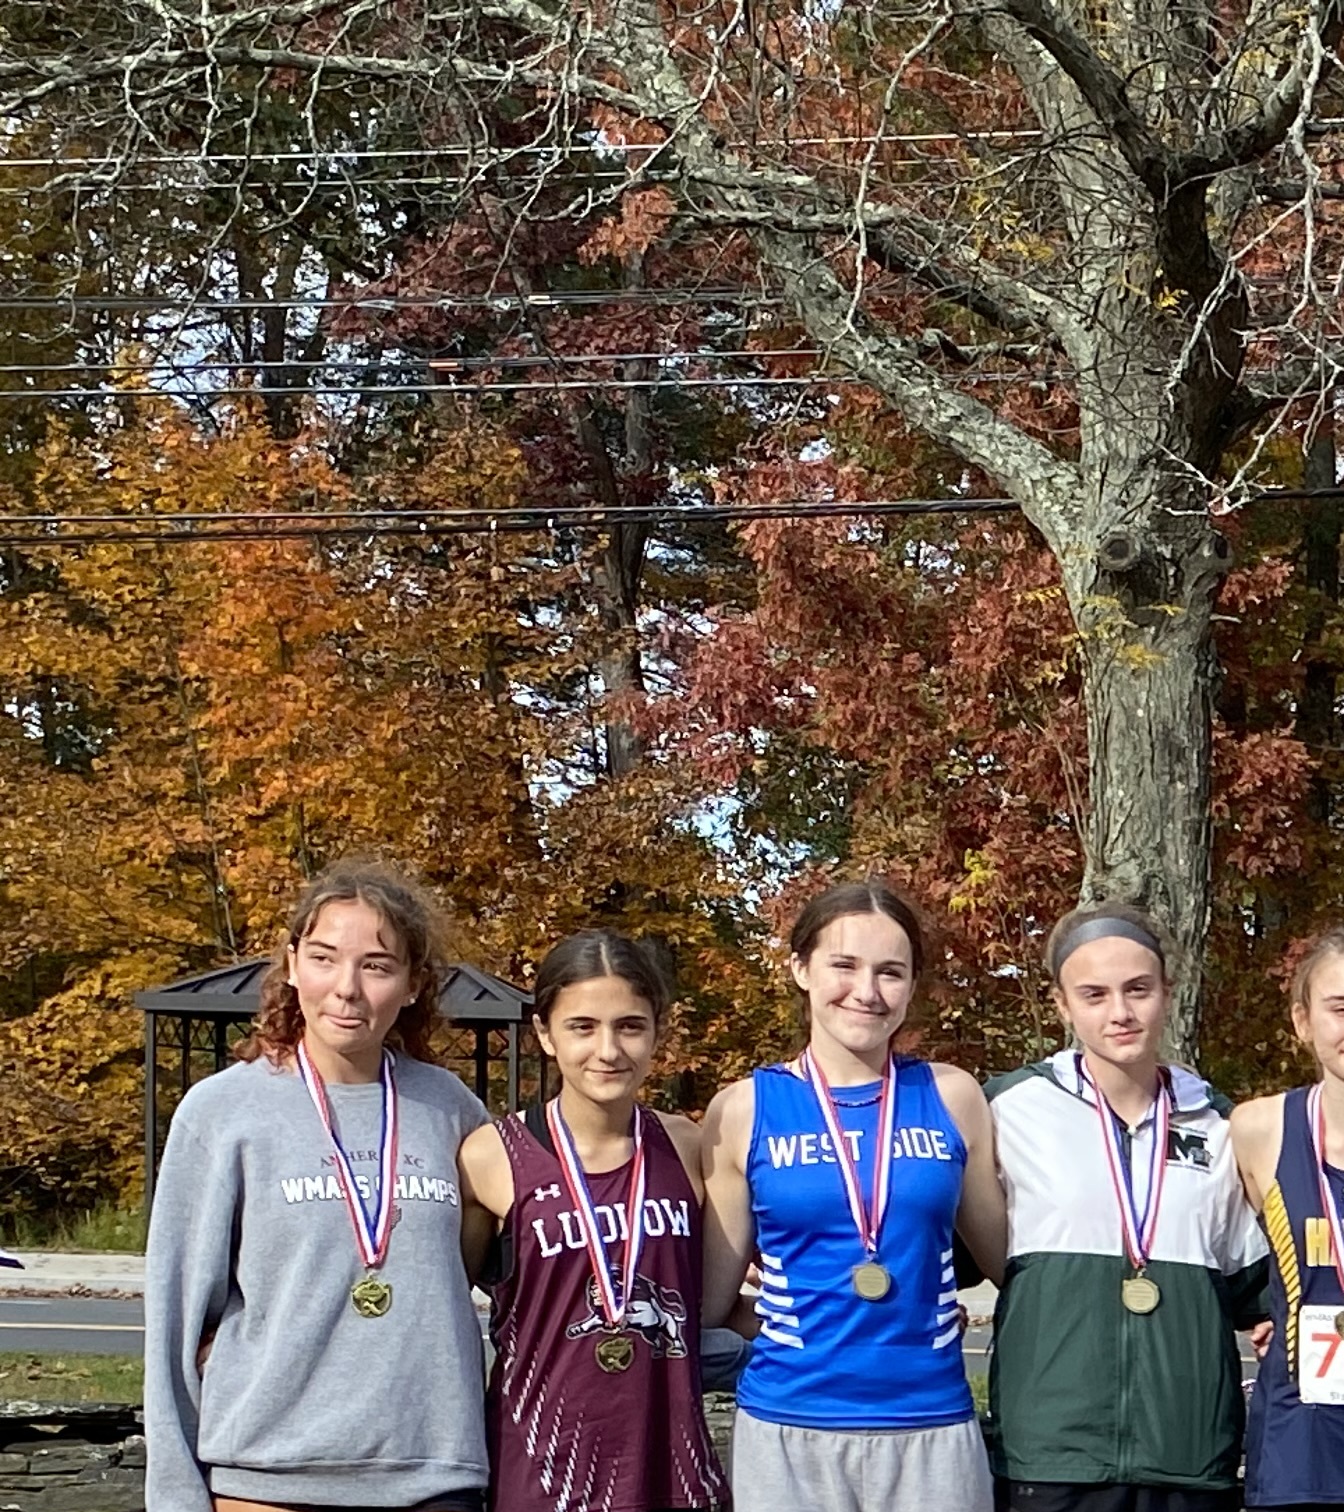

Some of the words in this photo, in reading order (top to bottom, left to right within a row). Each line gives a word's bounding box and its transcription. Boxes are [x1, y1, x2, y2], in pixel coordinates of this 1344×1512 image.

[403, 1154, 425, 1169] XC
[767, 1130, 864, 1169] WEST
[281, 1175, 370, 1204] WMAS
[375, 1175, 458, 1207] HAMPS
